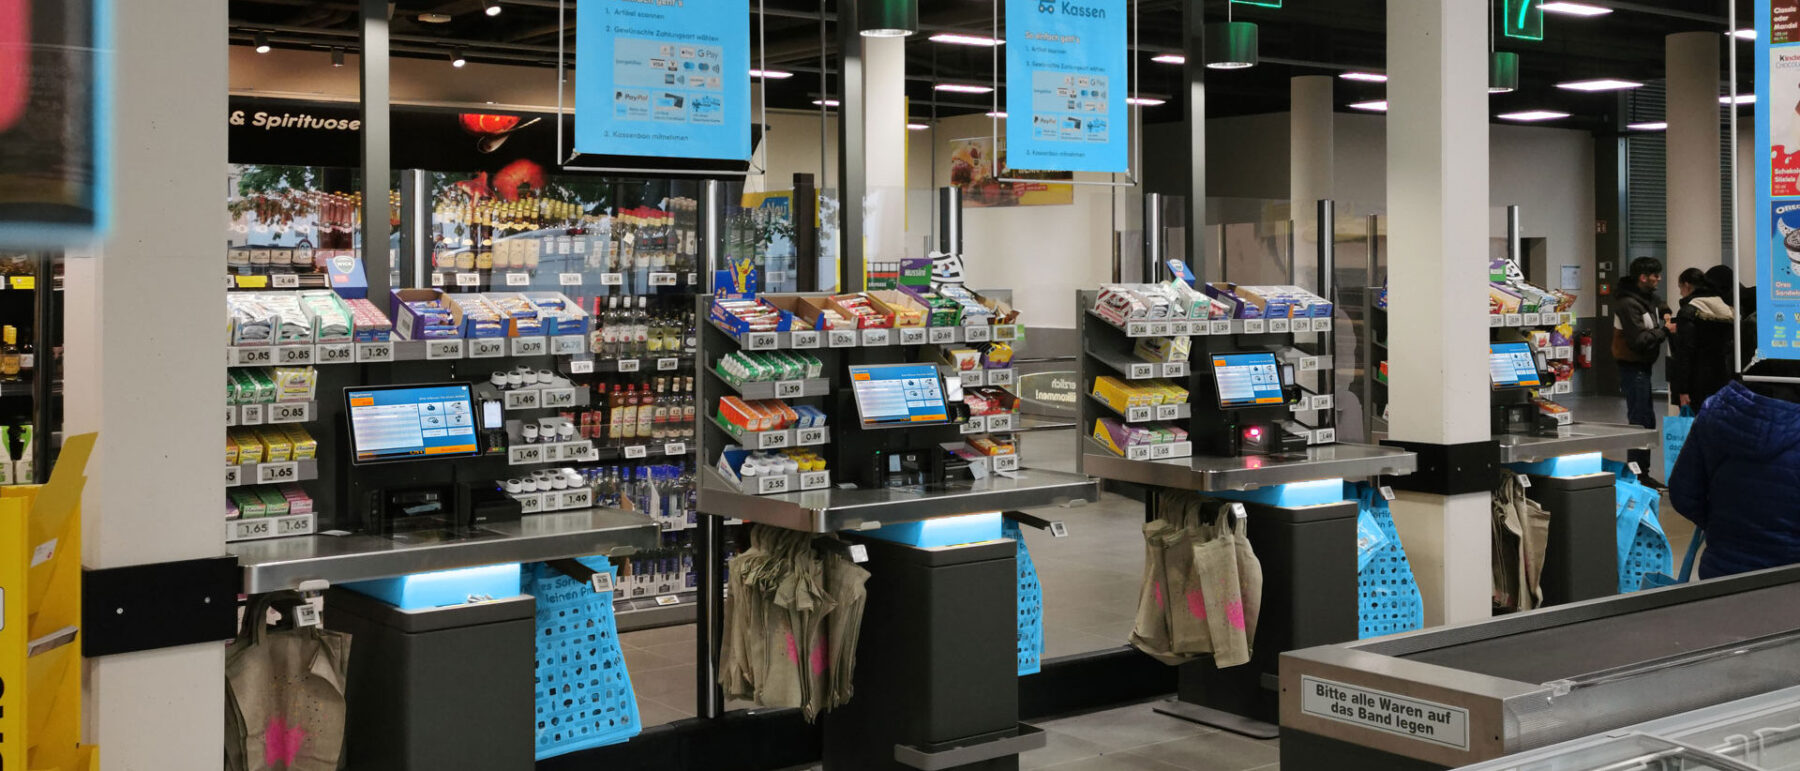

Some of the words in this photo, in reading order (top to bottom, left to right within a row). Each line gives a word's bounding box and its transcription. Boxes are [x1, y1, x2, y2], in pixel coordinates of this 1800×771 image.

[1062, 1, 1105, 18] Kassen
[614, 26, 654, 36] Gewünschte
[656, 30, 696, 41] Zahlungsart
[625, 93, 649, 101] PayPal
[229, 110, 245, 125] &
[252, 112, 360, 130] Spirituose
[613, 131, 650, 139] Kassenbon
[480, 344, 500, 352] 0.79
[522, 342, 541, 350] 0.79
[247, 352, 270, 360] 0.85
[287, 350, 310, 359] 0.85
[328, 349, 350, 358] 0.85
[368, 348, 390, 357] 1.29
[515, 396, 535, 405] 1.49
[552, 394, 571, 402] 1.99
[281, 408, 304, 417] 0.85
[519, 450, 539, 459] 1.49
[569, 446, 588, 455] 1.49
[270, 468, 292, 478] 1.65
[522, 499, 537, 507] .49
[568, 494, 588, 503] 1.49
[246, 524, 268, 534] 1.65
[286, 521, 308, 531] 1.65
[1315, 684, 1347, 702] Bitte
[1351, 693, 1375, 708] alle
[1379, 697, 1423, 718] Waren
[1428, 711, 1451, 725] auf
[1331, 702, 1354, 717] das
[1358, 708, 1392, 726] Band
[1396, 715, 1434, 736] legen
